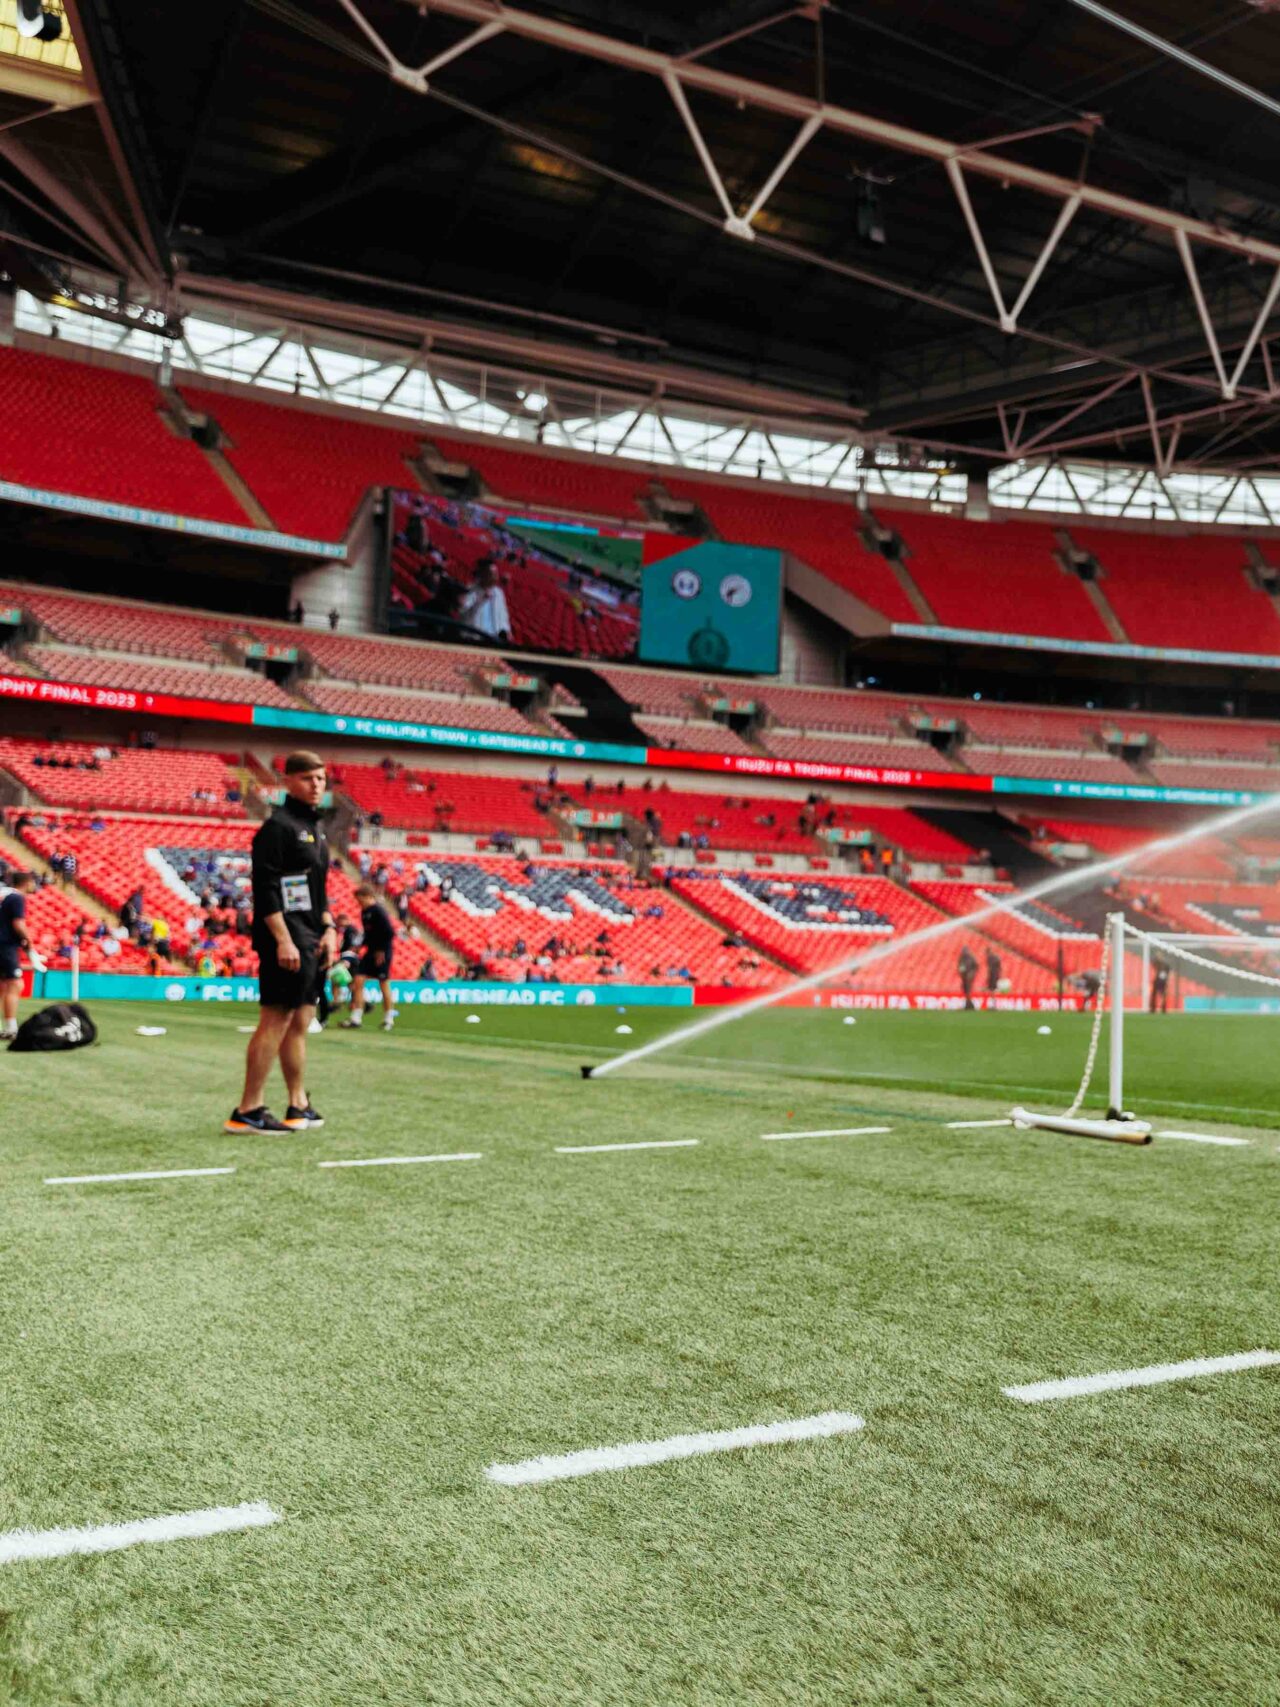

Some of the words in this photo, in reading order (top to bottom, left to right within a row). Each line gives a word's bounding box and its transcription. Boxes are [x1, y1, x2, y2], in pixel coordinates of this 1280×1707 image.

[40, 683, 92, 703] FINAL
[96, 690, 137, 708] 2023
[202, 985, 232, 1001] FC
[419, 988, 536, 1005] GATESHEAD
[539, 990, 565, 1005] FC
[831, 993, 885, 1009] ISUZU
[888, 995, 911, 1010] FA
